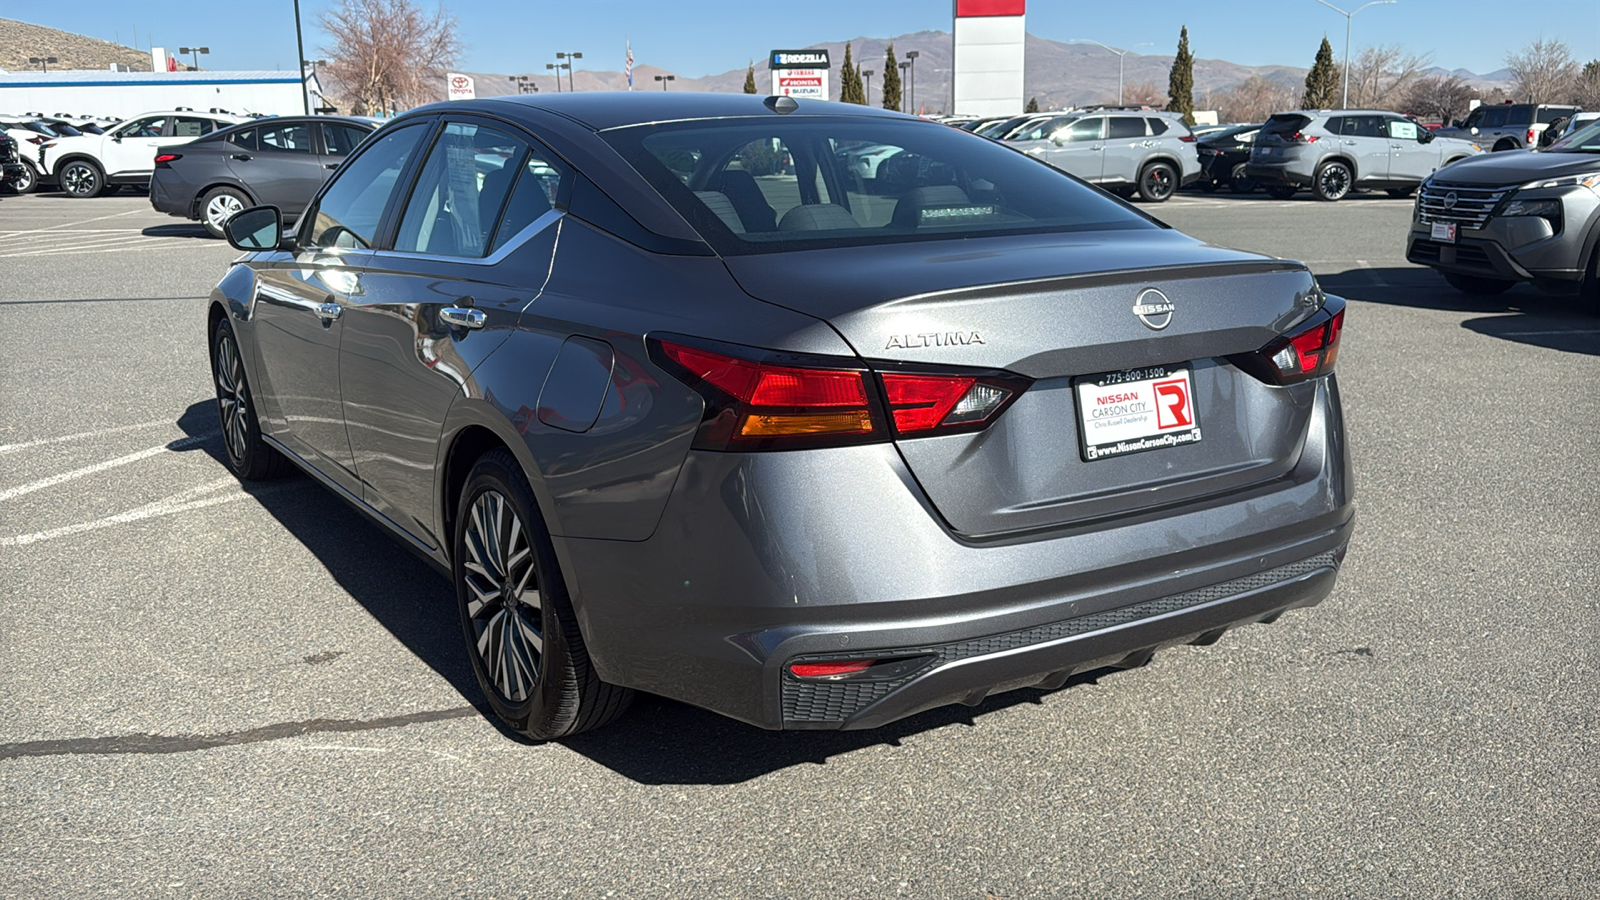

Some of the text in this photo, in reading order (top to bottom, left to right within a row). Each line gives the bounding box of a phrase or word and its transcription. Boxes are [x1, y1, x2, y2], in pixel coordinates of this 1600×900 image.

[1133, 303, 1176, 316] NISSAN
[885, 330, 987, 350] ALTIMA
[1106, 367, 1165, 384] 775-600-1500
[1096, 391, 1139, 406] NISSAN
[1092, 402, 1147, 419] CARSON CITY
[1097, 434, 1192, 456] www.NissanCarsonCity.com
